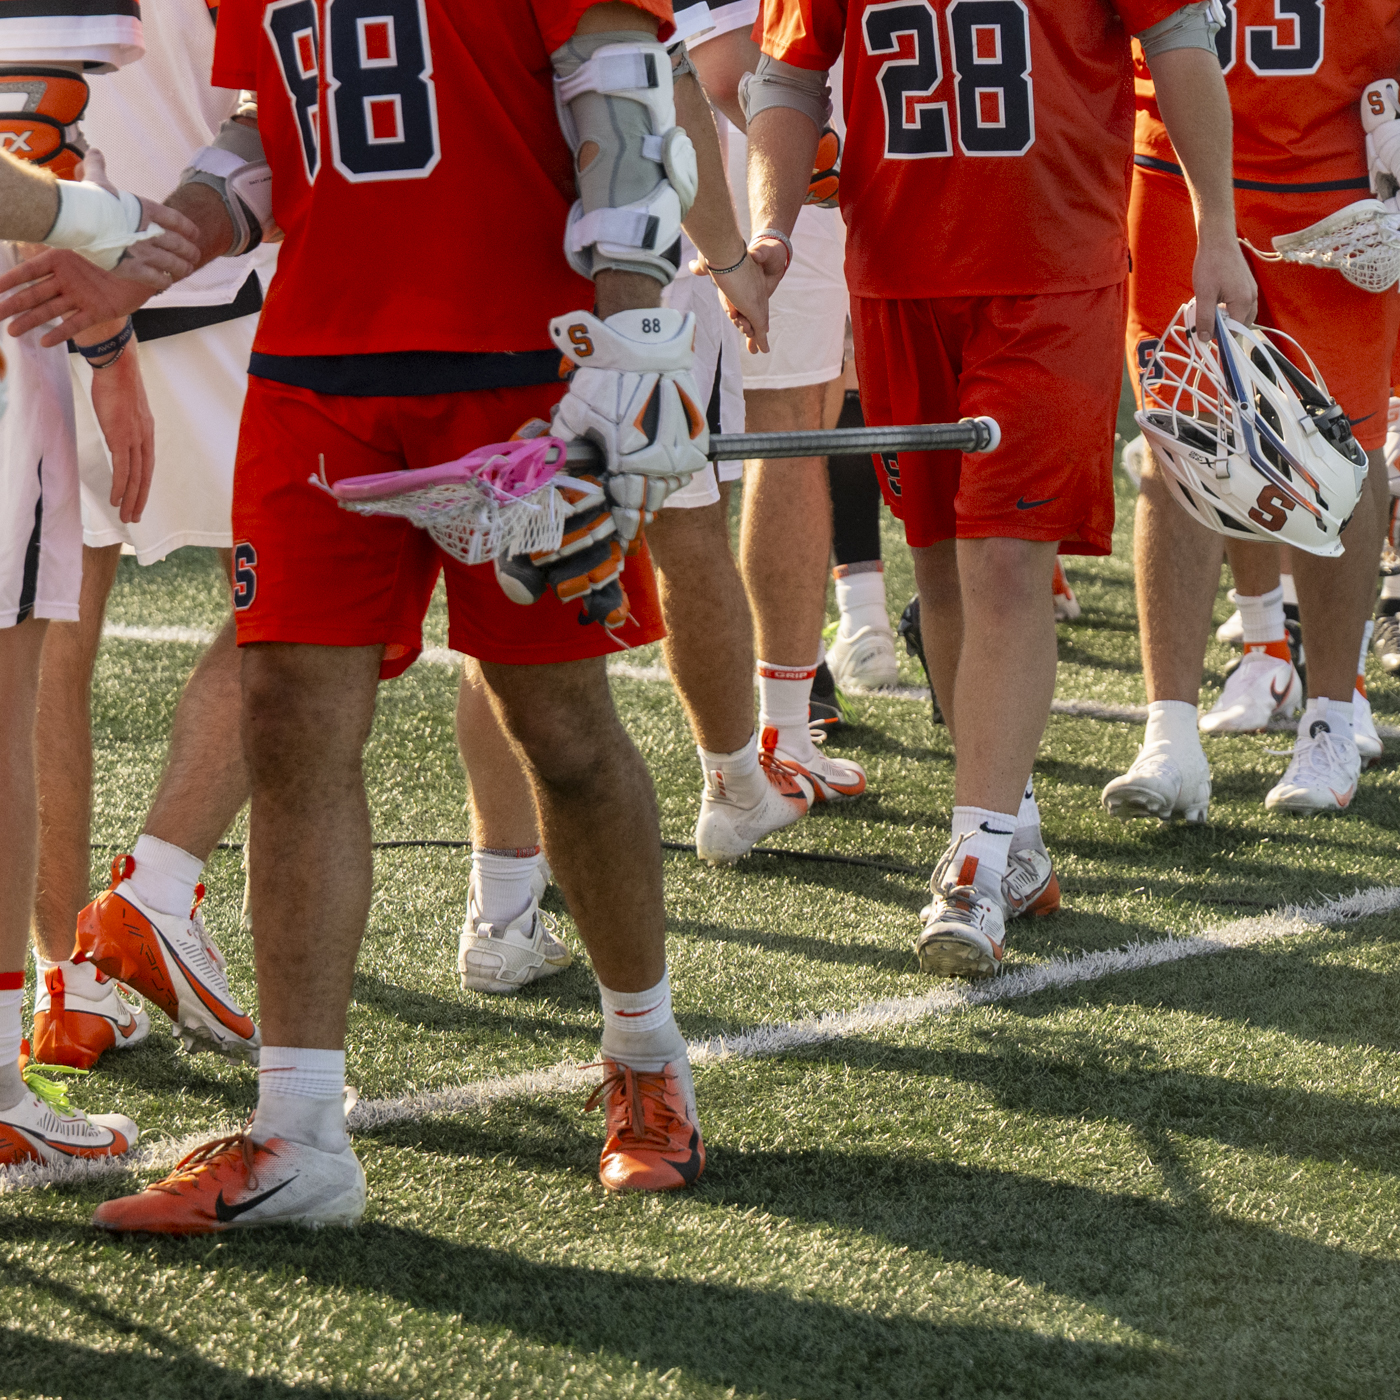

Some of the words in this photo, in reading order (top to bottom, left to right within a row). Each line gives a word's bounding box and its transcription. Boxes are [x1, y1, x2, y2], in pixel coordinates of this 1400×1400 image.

[1367, 89, 1386, 116] S
[567, 323, 596, 358] S
[642, 317, 662, 335] 88
[1247, 483, 1297, 532] S
[233, 542, 258, 612] S
[773, 670, 808, 680] GRIP
